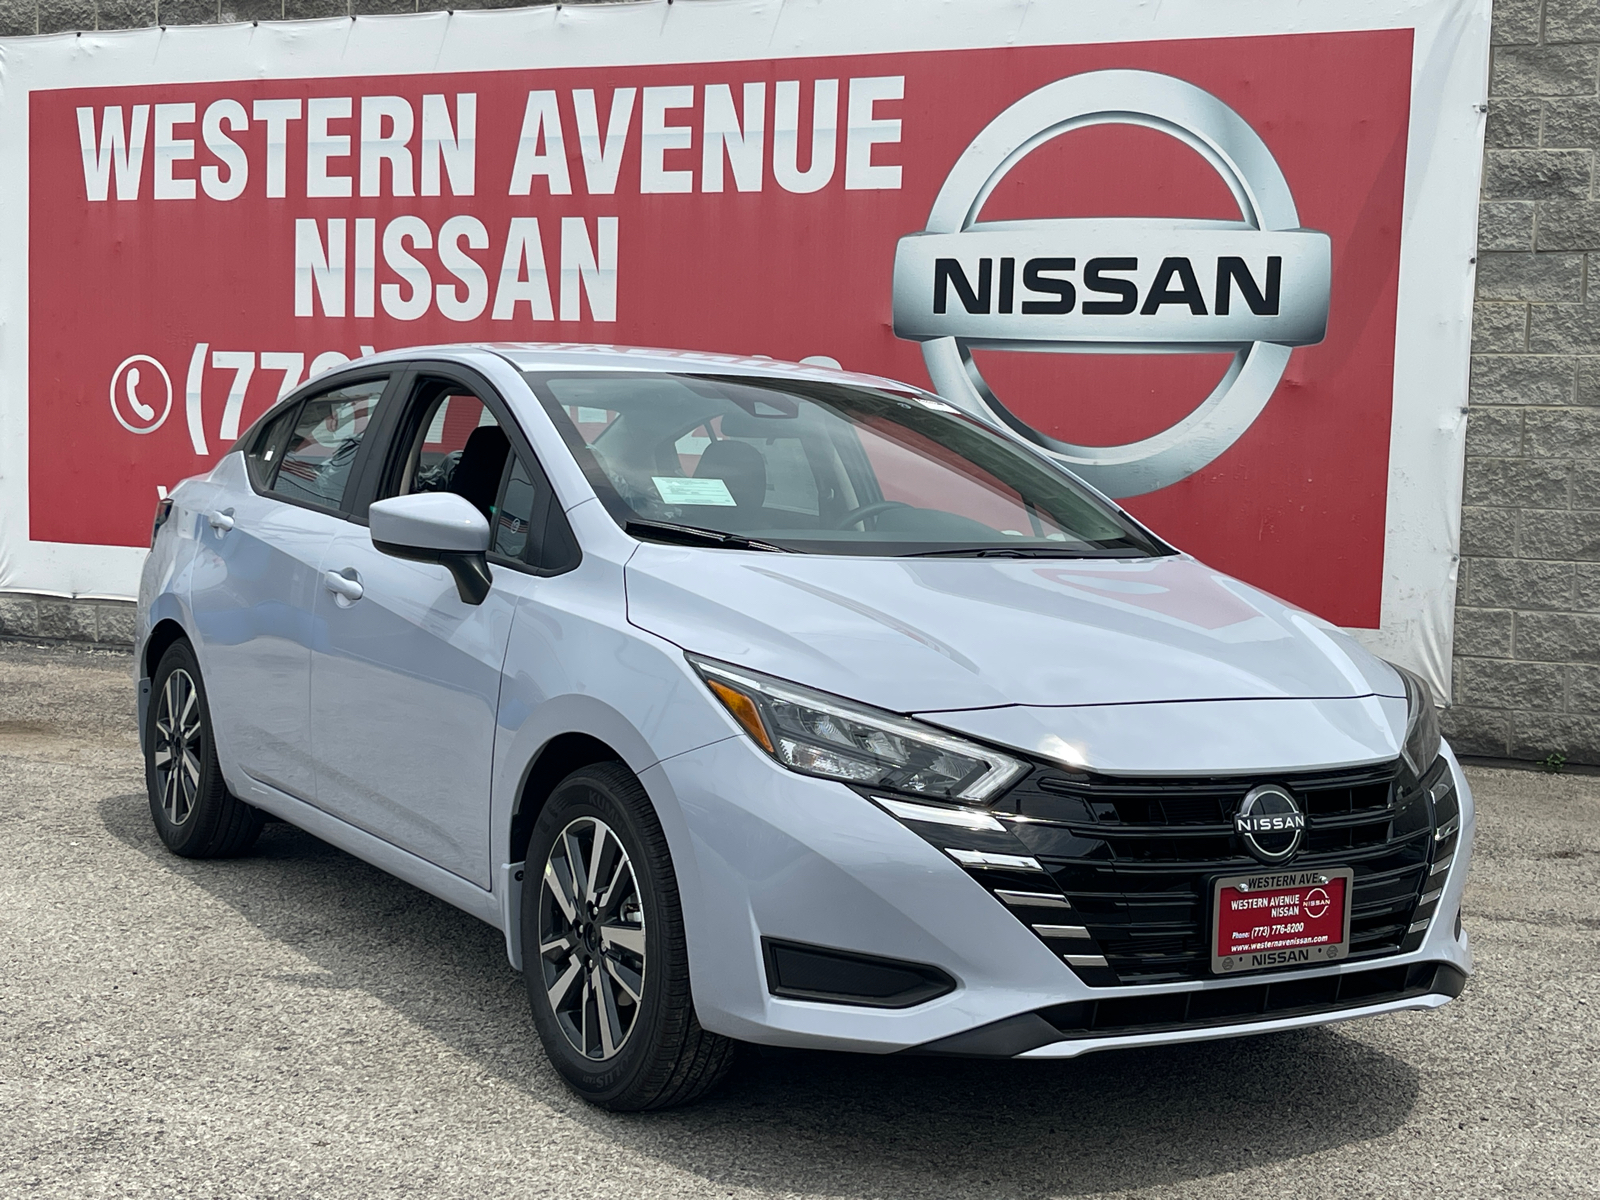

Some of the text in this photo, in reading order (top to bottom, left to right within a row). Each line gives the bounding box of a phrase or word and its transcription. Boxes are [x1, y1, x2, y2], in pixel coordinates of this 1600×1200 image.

[76, 75, 905, 202] WESTERN AVENUE
[294, 215, 619, 323] NISSAN
[933, 256, 1283, 316] NISSAN
[1237, 815, 1305, 831] NISSAN
[1248, 874, 1297, 889] WESTERN
[1231, 894, 1300, 911] WESTERN AVENUE
[1302, 899, 1331, 907] NISSAN
[1271, 905, 1299, 918] NISSAN
[1231, 922, 1304, 940] Phone: (773) 776-8200
[1231, 935, 1329, 952] www.westernavenissan.com
[1252, 948, 1309, 967] NISSAN
